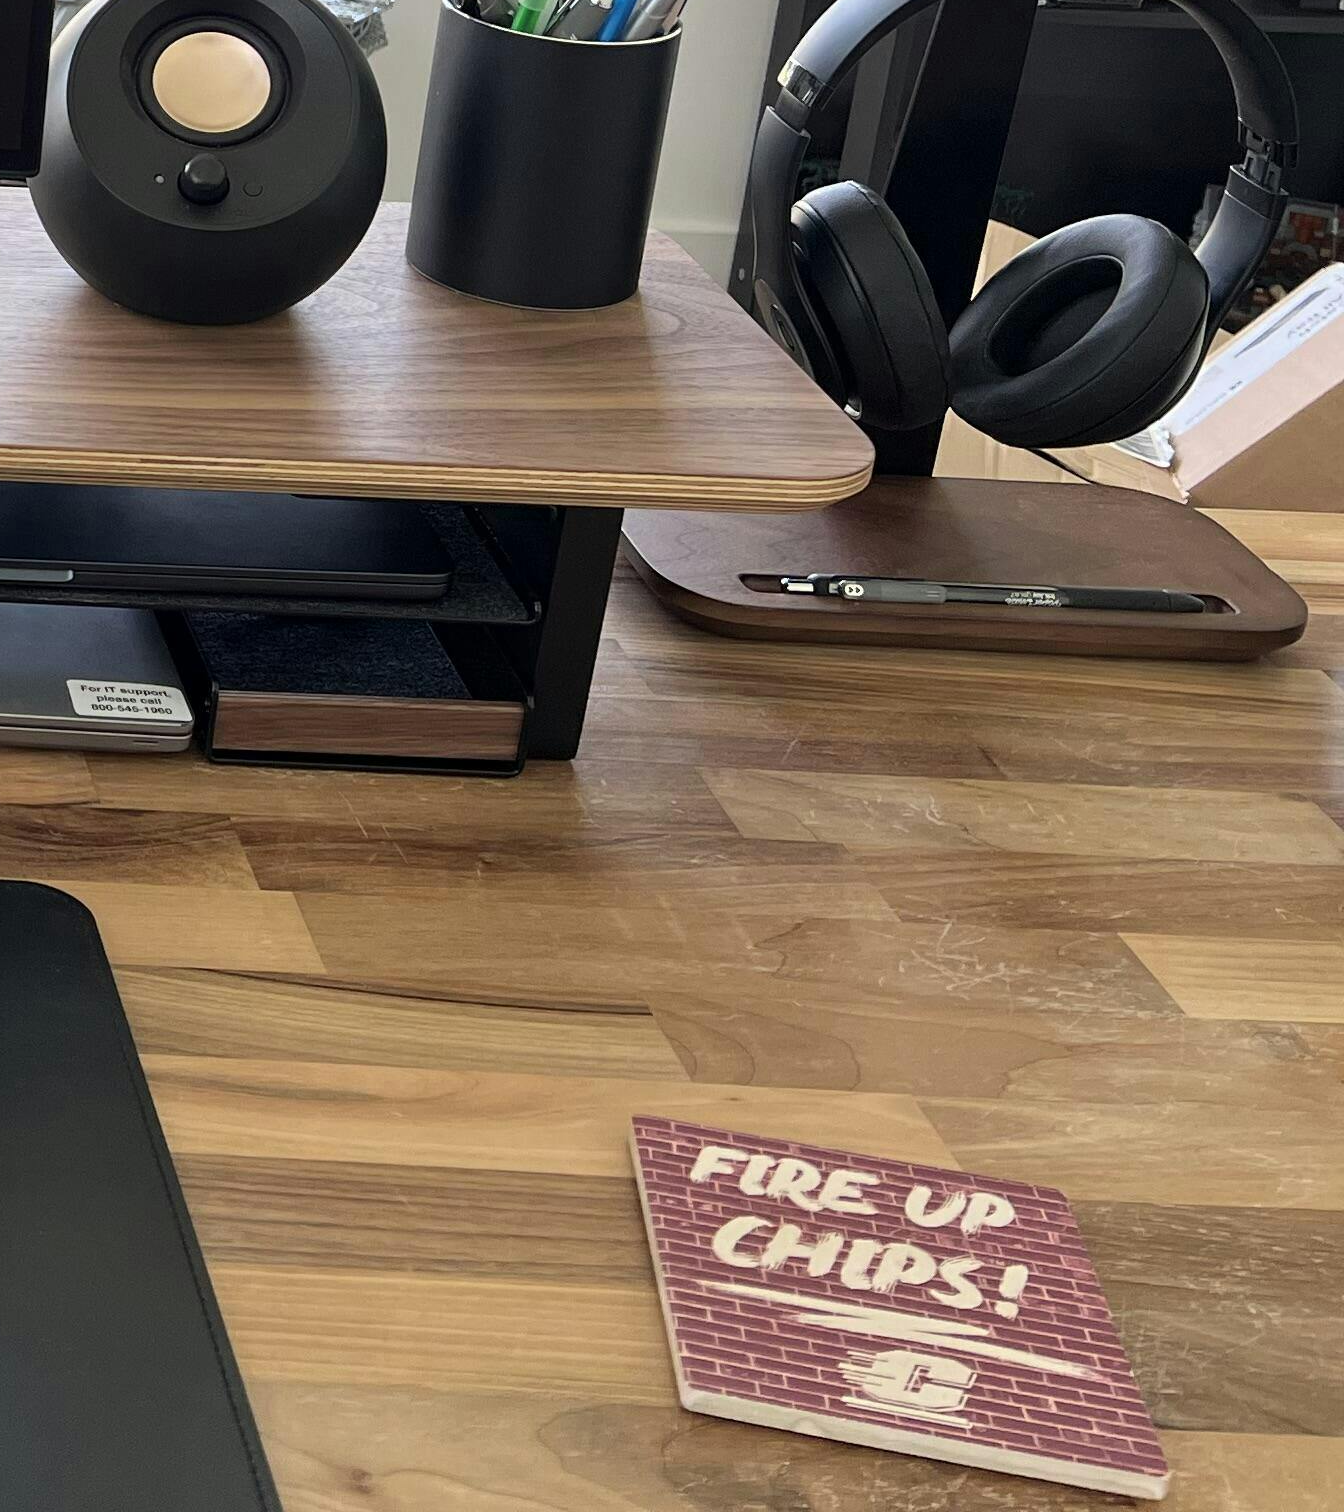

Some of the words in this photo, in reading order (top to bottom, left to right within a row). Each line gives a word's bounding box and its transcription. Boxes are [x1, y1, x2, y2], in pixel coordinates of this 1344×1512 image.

[80, 684, 101, 693] For
[104, 685, 117, 694] IT
[96, 695, 137, 704] please
[140, 697, 162, 705] call
[689, 1145, 881, 1216] FIRE
[905, 1185, 1016, 1236] UP
[712, 1215, 1029, 1320] CHIPS!
